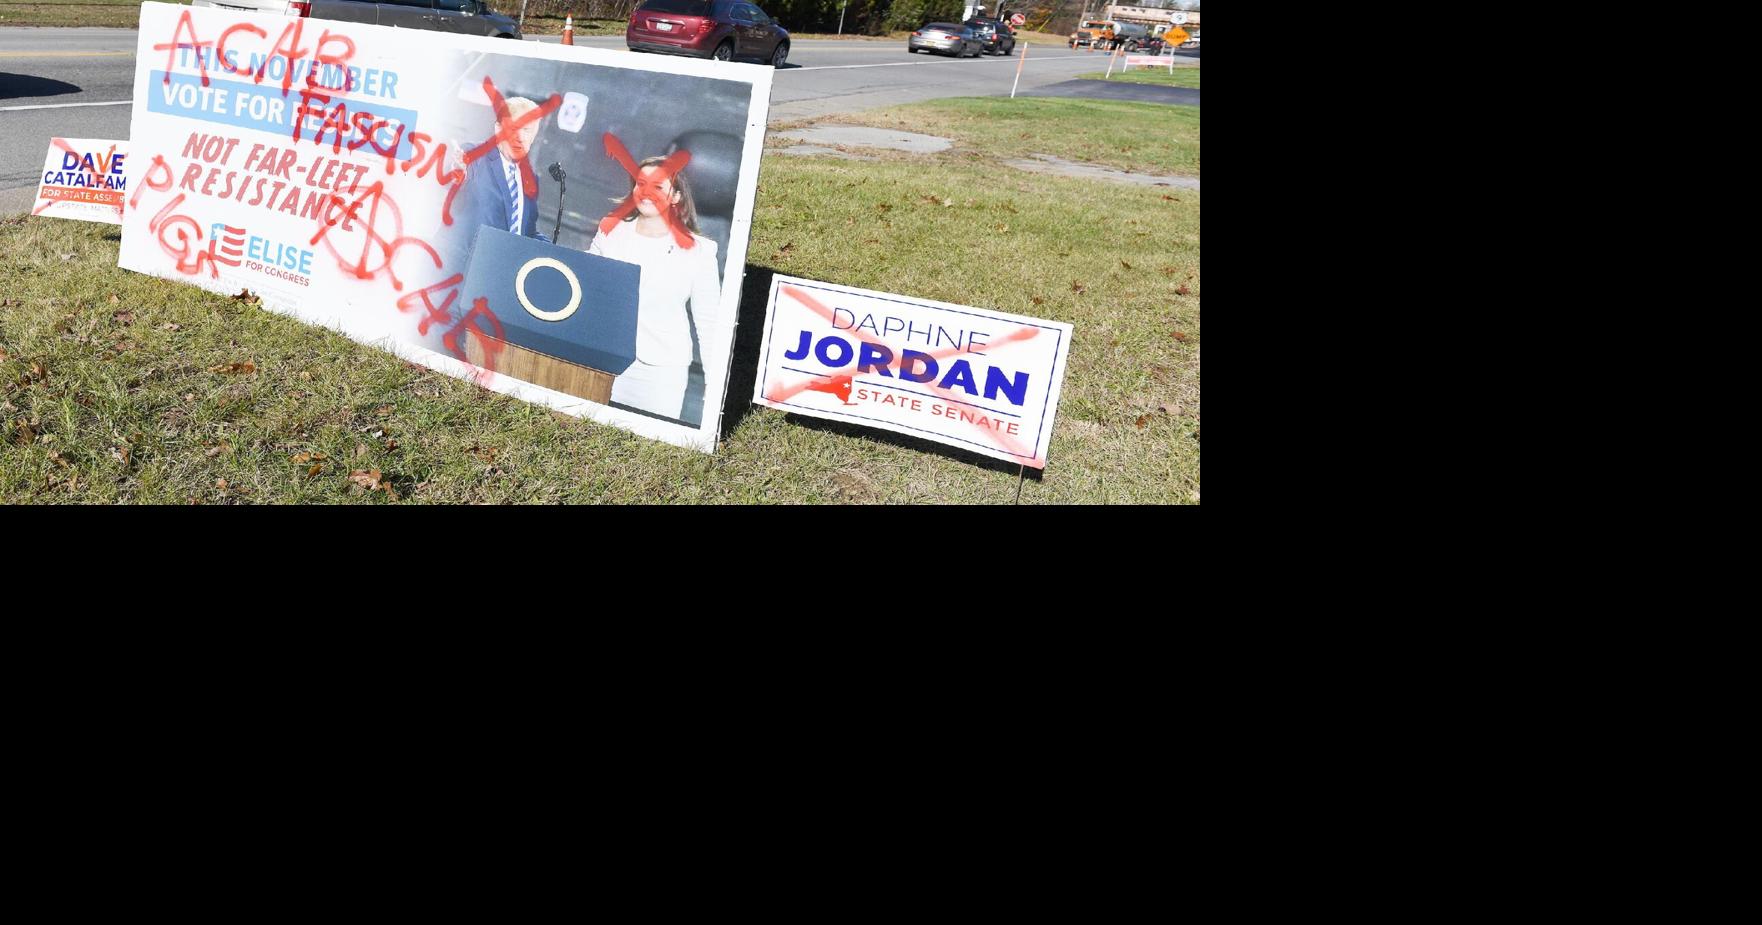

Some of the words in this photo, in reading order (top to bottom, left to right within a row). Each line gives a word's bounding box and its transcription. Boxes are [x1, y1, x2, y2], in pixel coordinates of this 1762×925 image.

[153, 9, 356, 98] ACAB
[177, 43, 238, 73] THIS
[250, 53, 399, 99] NOVEMBER
[162, 82, 228, 114] VOTE
[235, 91, 284, 126] FOR
[62, 144, 125, 174] DAVE
[181, 131, 240, 166] NOT
[244, 143, 370, 197] FAR-LEFT
[42, 188, 61, 197] FOR
[63, 190, 91, 200] STATE
[179, 162, 364, 232] RESISTANCE
[245, 260, 263, 273] FOR
[264, 264, 310, 287] CONGRESS
[247, 235, 314, 276] ELISE
[832, 307, 990, 356] DAPHNE
[784, 330, 1030, 407] JORDAN
[857, 388, 922, 412] STATE
[931, 404, 1020, 436] SENATE
